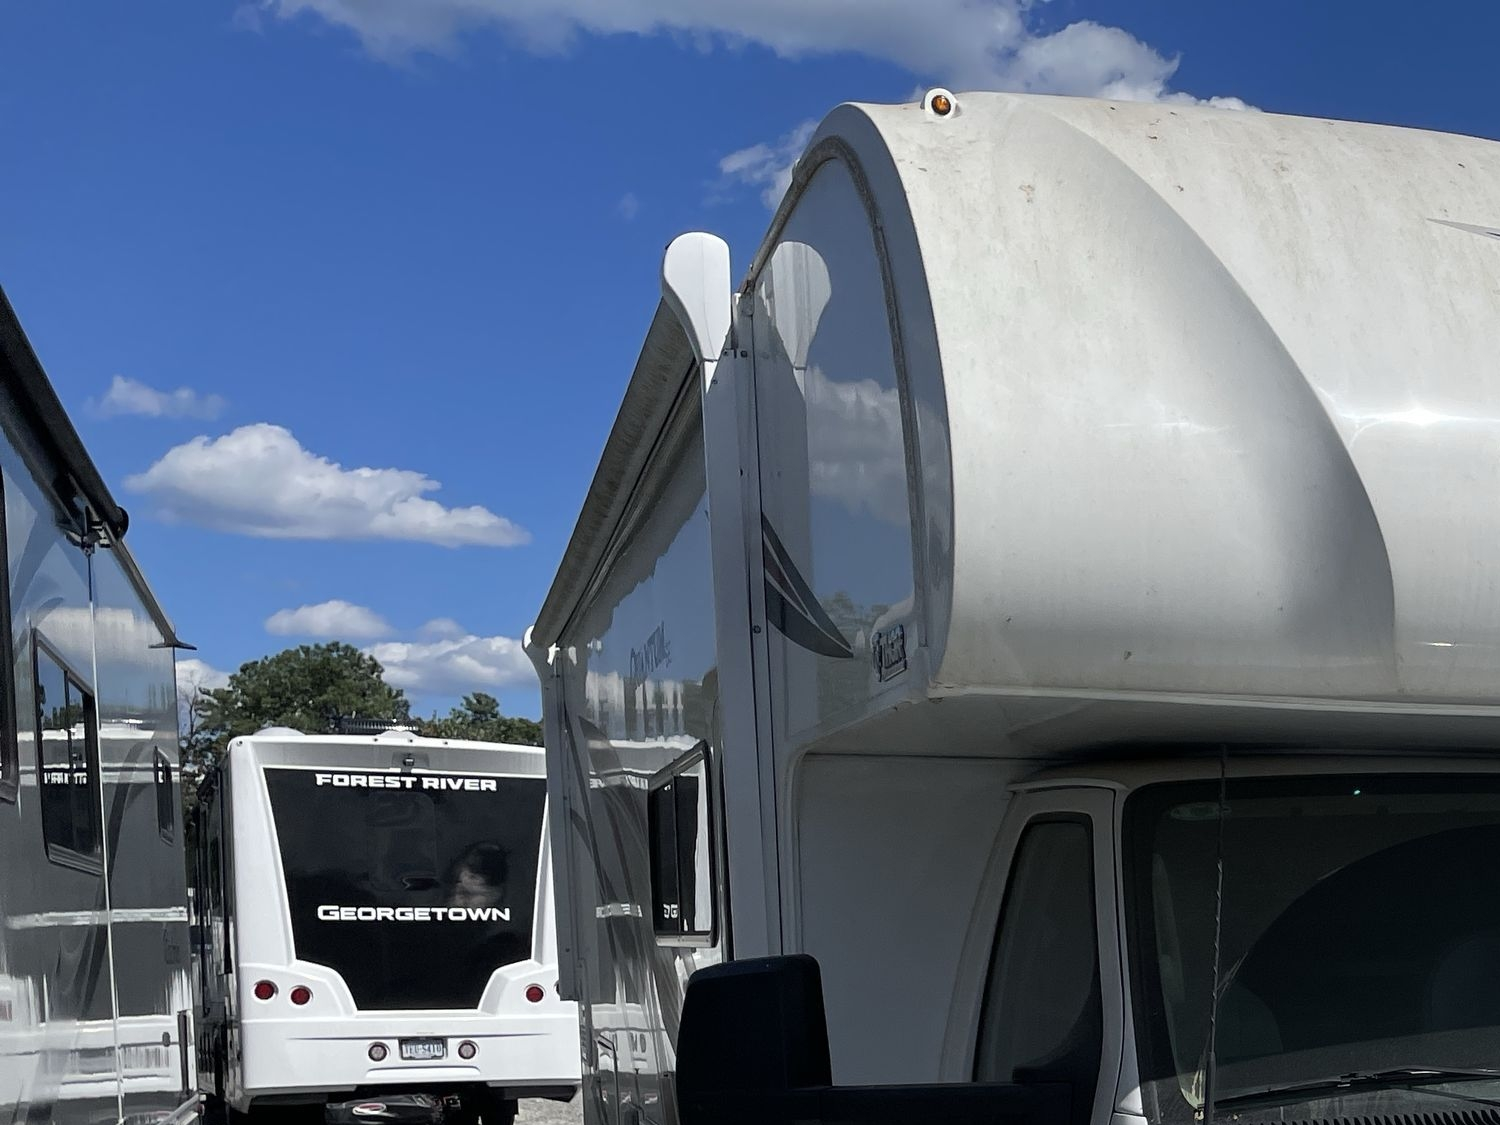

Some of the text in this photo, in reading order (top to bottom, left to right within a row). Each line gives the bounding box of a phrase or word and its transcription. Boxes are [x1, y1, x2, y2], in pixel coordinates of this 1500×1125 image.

[315, 773, 497, 792] FOREST RIVER
[317, 904, 511, 921] GEORGETOWN
